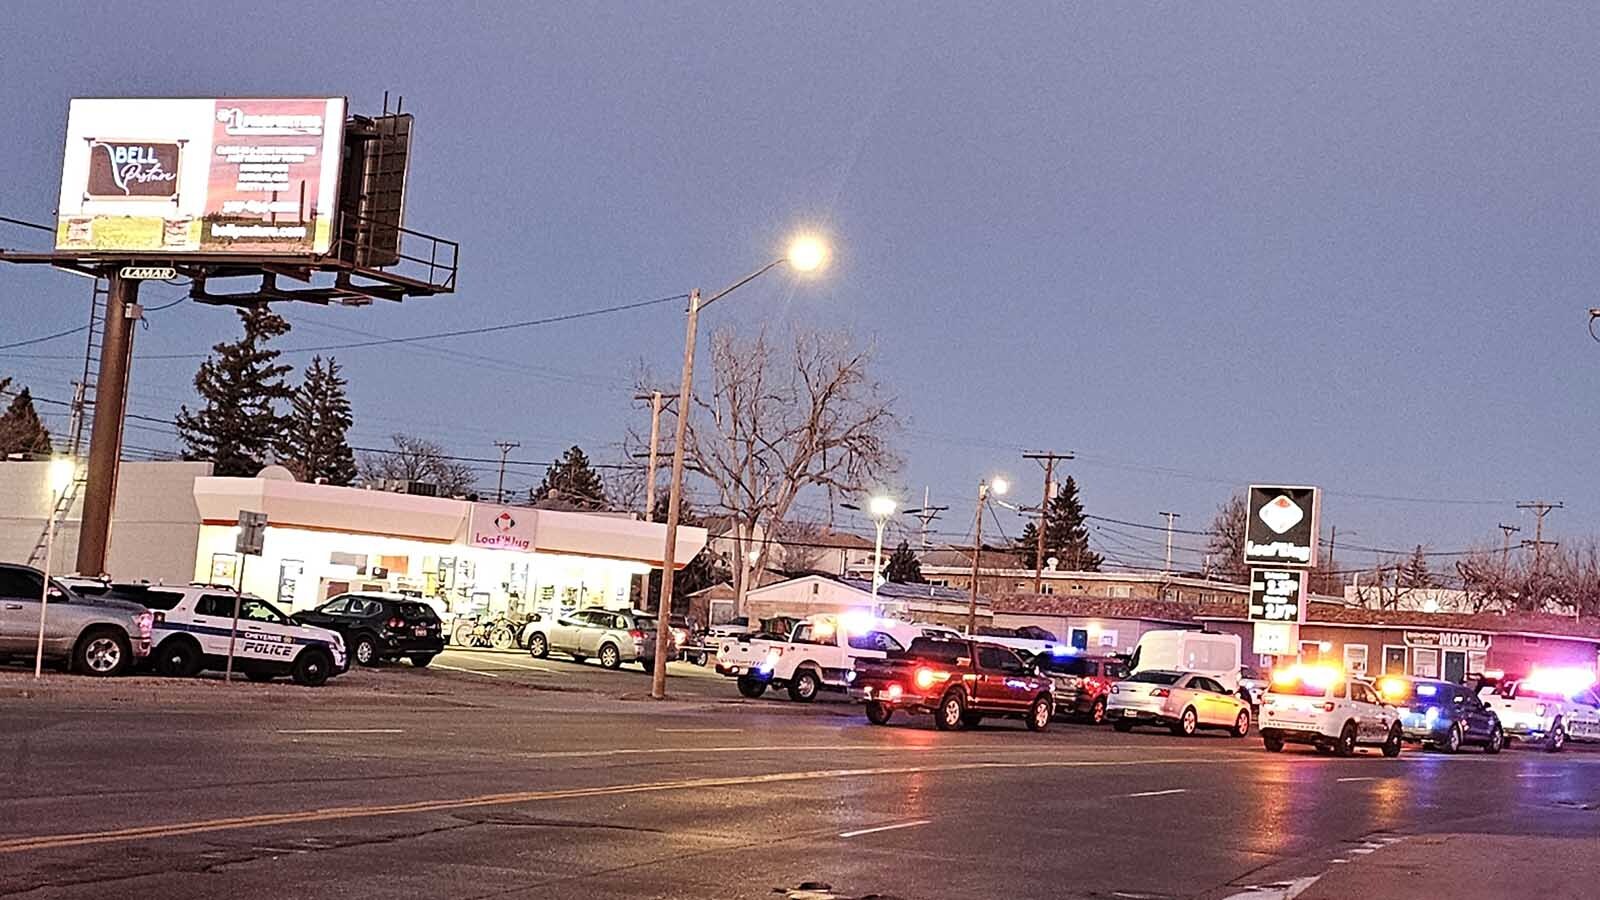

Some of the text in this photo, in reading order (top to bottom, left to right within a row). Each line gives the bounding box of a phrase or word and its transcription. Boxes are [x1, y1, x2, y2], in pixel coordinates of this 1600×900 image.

[116, 146, 158, 164] BELL
[124, 267, 171, 279] LAMAR
[1439, 632, 1486, 648] MOTEL
[243, 642, 292, 656] POLICE
